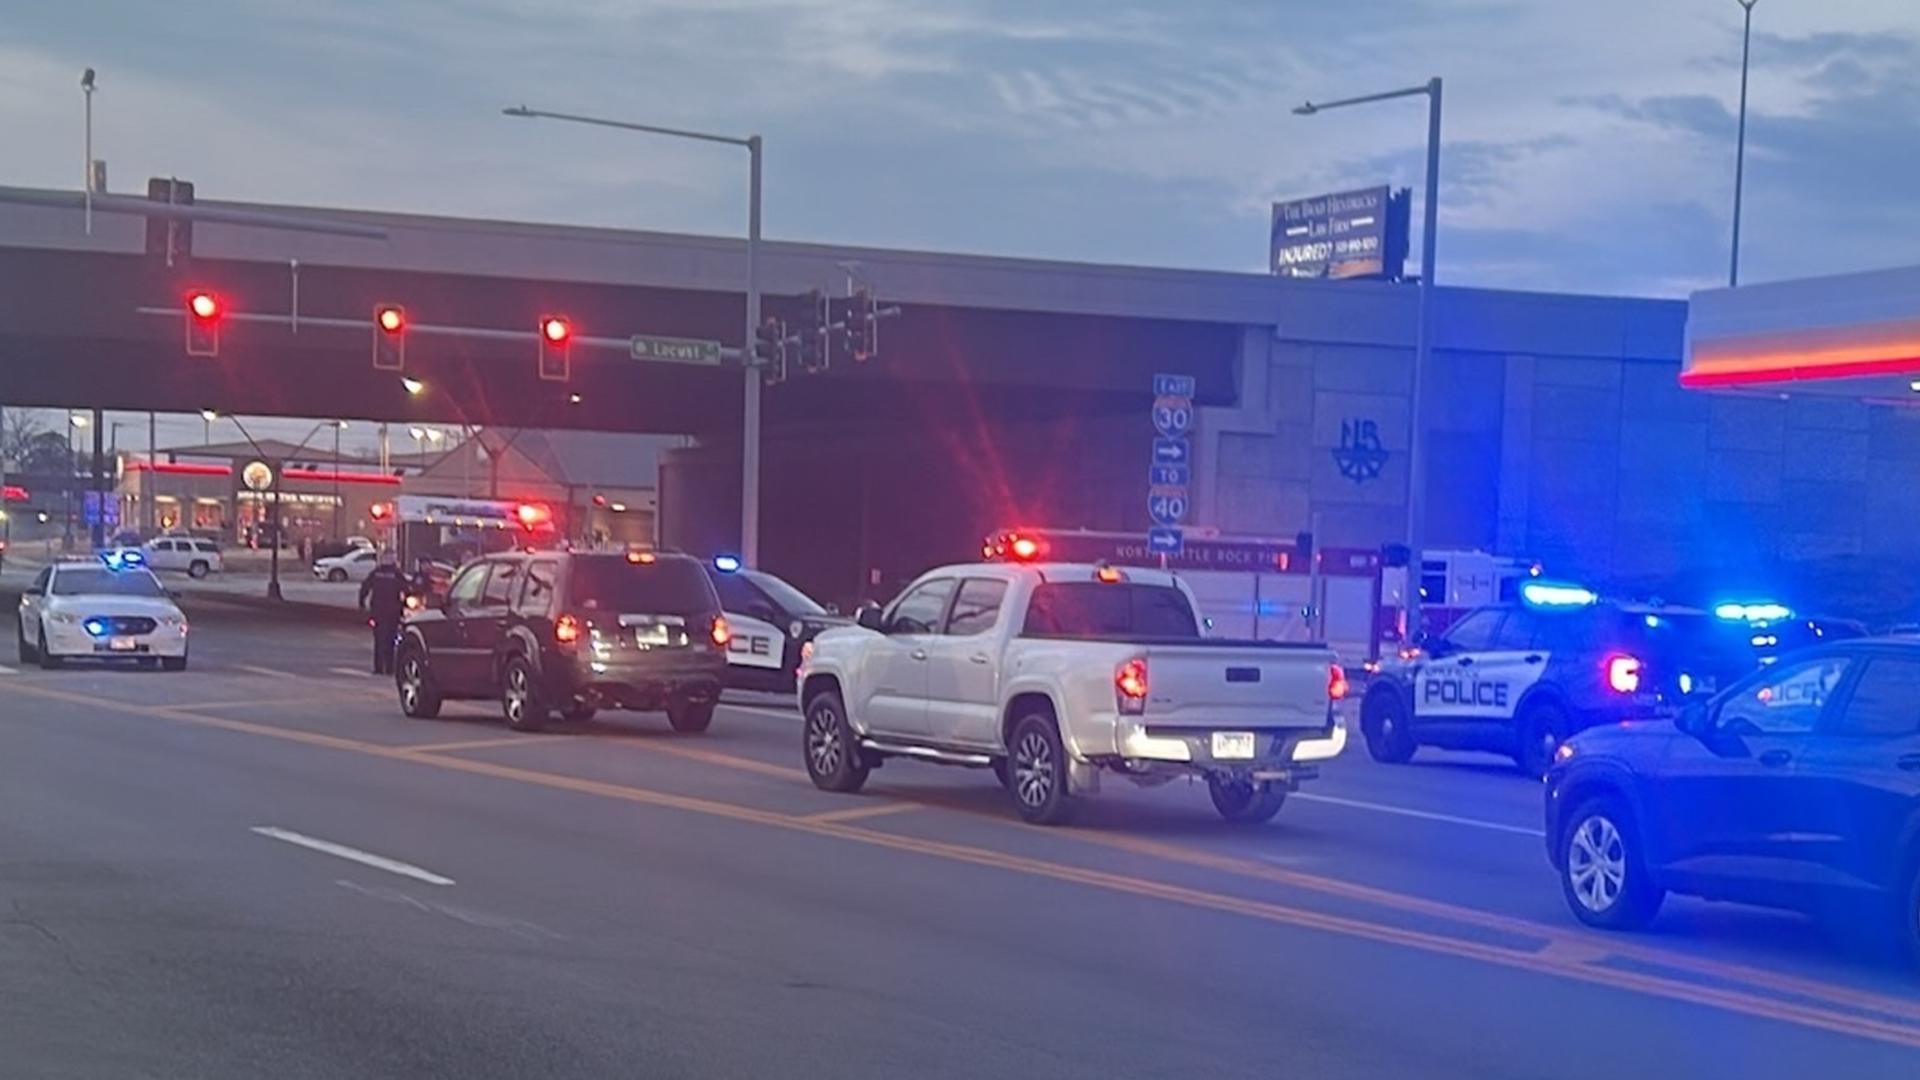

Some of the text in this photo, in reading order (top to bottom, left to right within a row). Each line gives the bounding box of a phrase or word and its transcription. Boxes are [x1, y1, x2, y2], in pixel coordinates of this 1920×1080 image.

[1279, 241, 1333, 265] INJURED?
[1159, 407, 1187, 429] 30
[1161, 469, 1179, 483] TO
[1155, 498, 1183, 518] 40
[1425, 679, 1508, 707] POLICE
